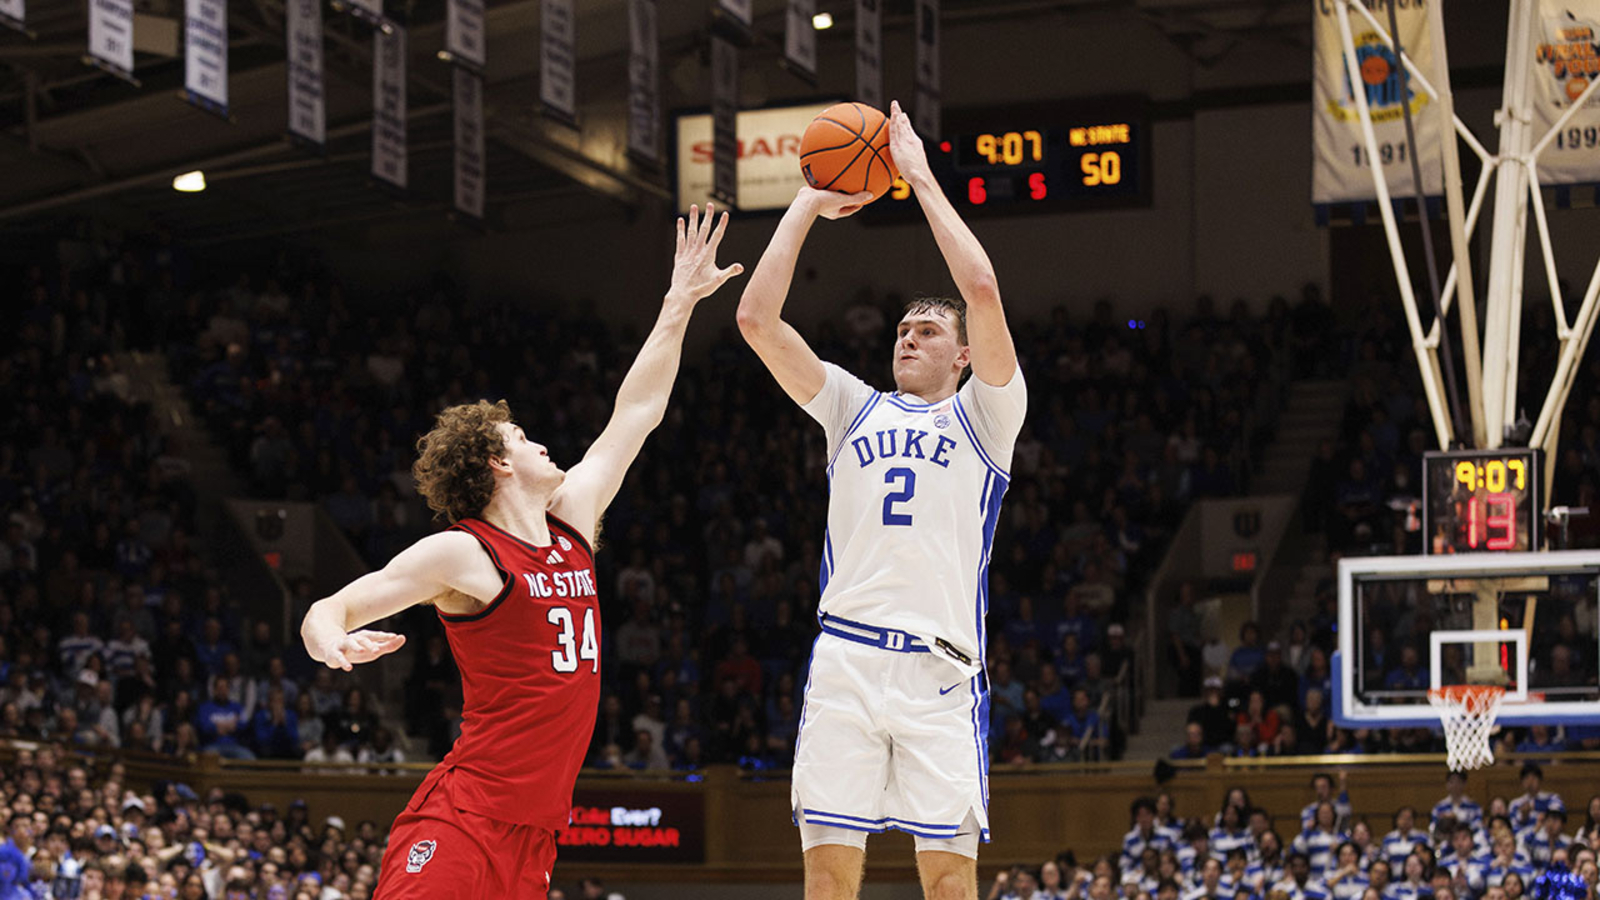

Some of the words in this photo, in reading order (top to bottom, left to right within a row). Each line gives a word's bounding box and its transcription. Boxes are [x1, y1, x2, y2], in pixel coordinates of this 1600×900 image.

[976, 130, 1042, 166] 9:07
[1557, 125, 1600, 150] 199
[1080, 150, 1121, 187] 50
[968, 176, 987, 205] 6
[1028, 172, 1047, 200] 5
[851, 428, 957, 469] DUKE
[1456, 459, 1525, 493] 9:07
[882, 467, 917, 527] 2
[1468, 492, 1516, 550] 13
[522, 570, 553, 599] NC
[546, 605, 599, 674] 34
[884, 631, 905, 651] D
[613, 827, 680, 848] SUGAR
